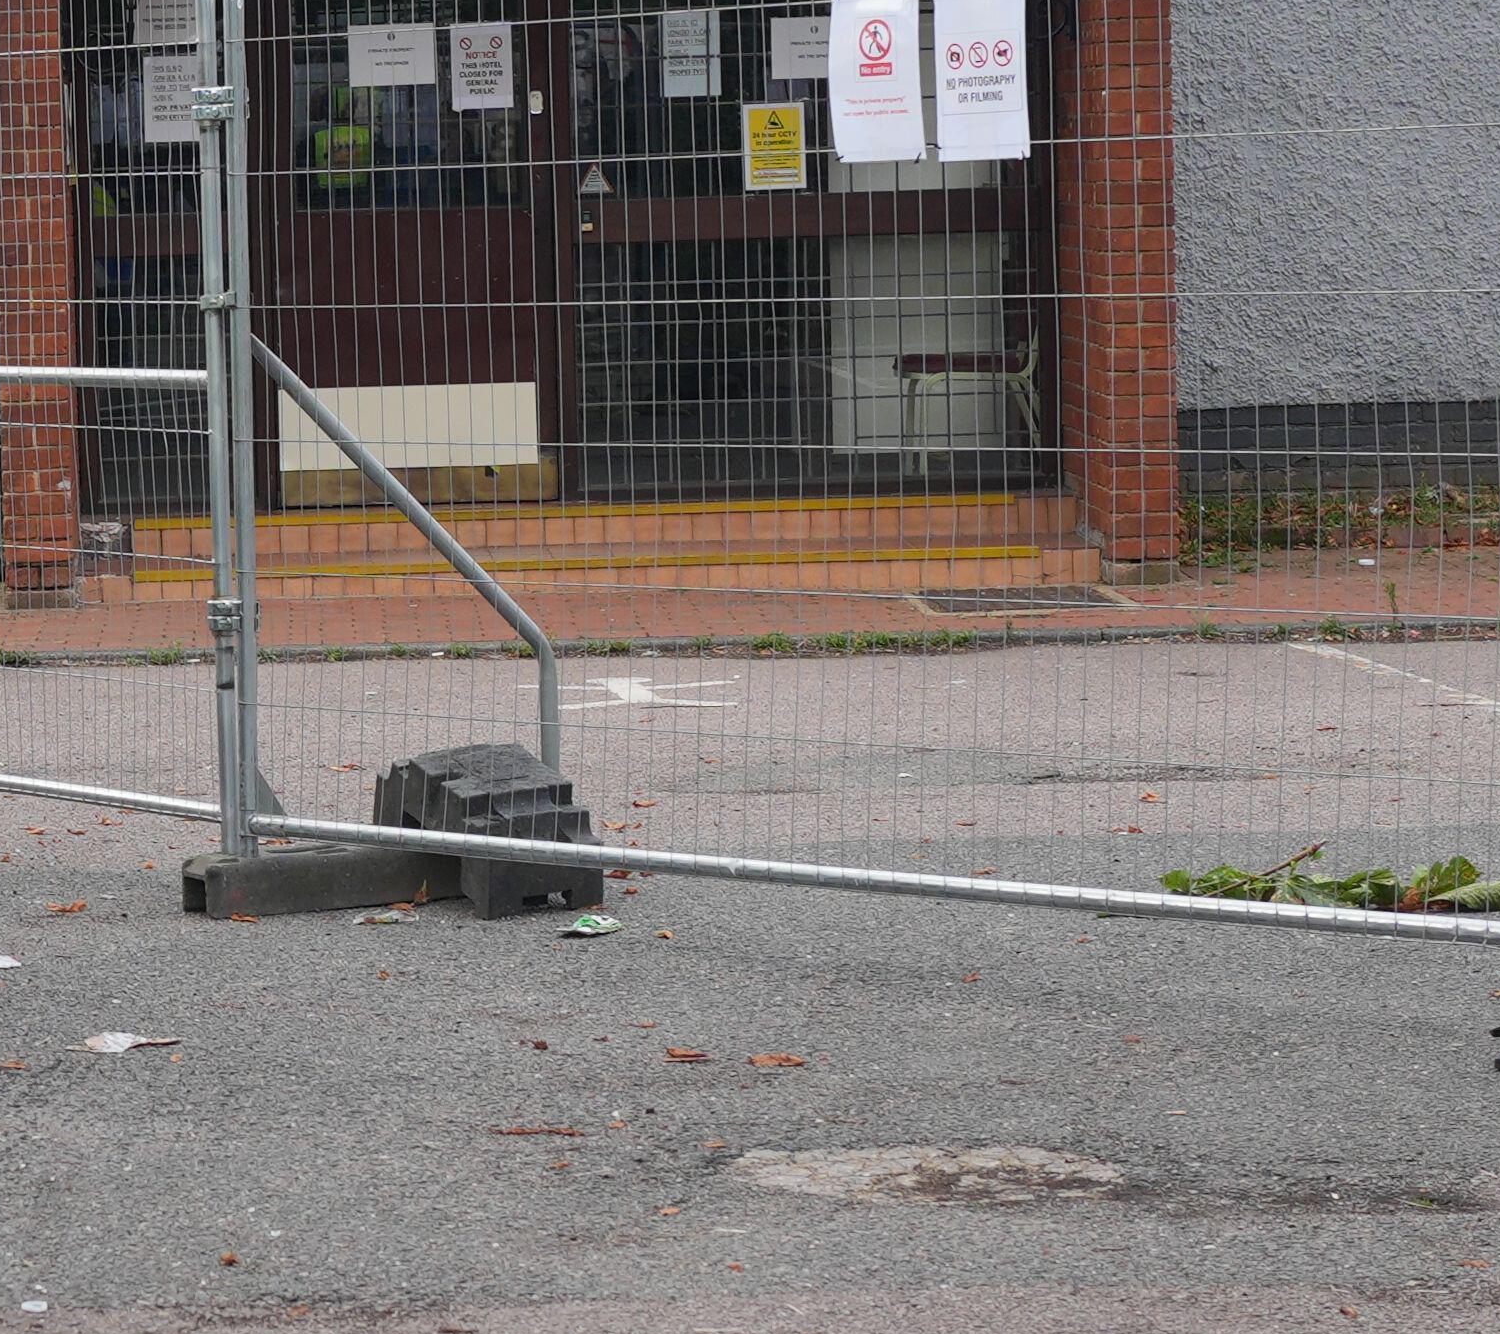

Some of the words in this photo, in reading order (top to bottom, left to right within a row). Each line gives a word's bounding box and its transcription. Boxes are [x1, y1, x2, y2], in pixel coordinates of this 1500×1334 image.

[465, 51, 497, 59] NOTICE
[459, 70, 487, 78] CLOSED
[861, 67, 871, 75] No
[872, 65, 891, 75] entry
[946, 78, 956, 90] NO
[958, 74, 1015, 88] PHOTOGRAPHY
[958, 92, 968, 103] OR
[970, 90, 1003, 102] FILMING
